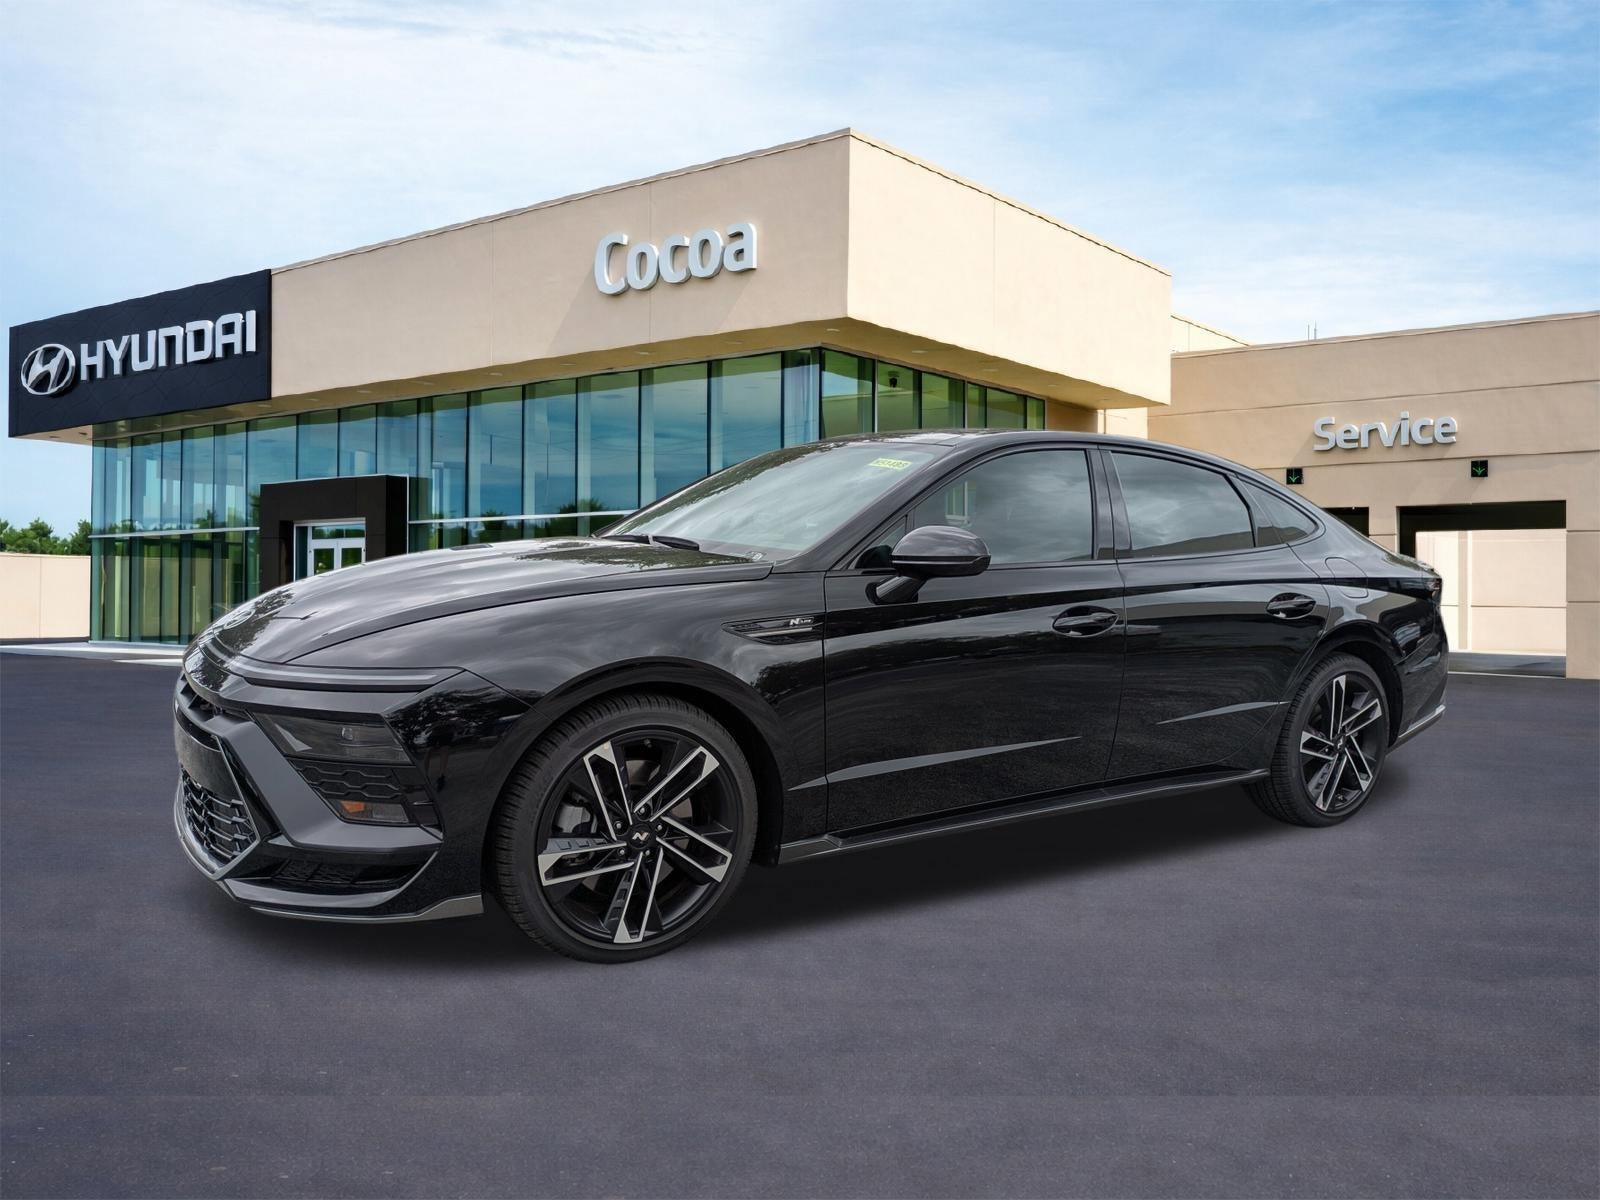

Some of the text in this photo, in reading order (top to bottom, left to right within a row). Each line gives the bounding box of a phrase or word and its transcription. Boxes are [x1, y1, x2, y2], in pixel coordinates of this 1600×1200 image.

[594, 222, 757, 295] Cocoa
[80, 310, 257, 381] HYUNDAI
[1313, 411, 1458, 451] Service
